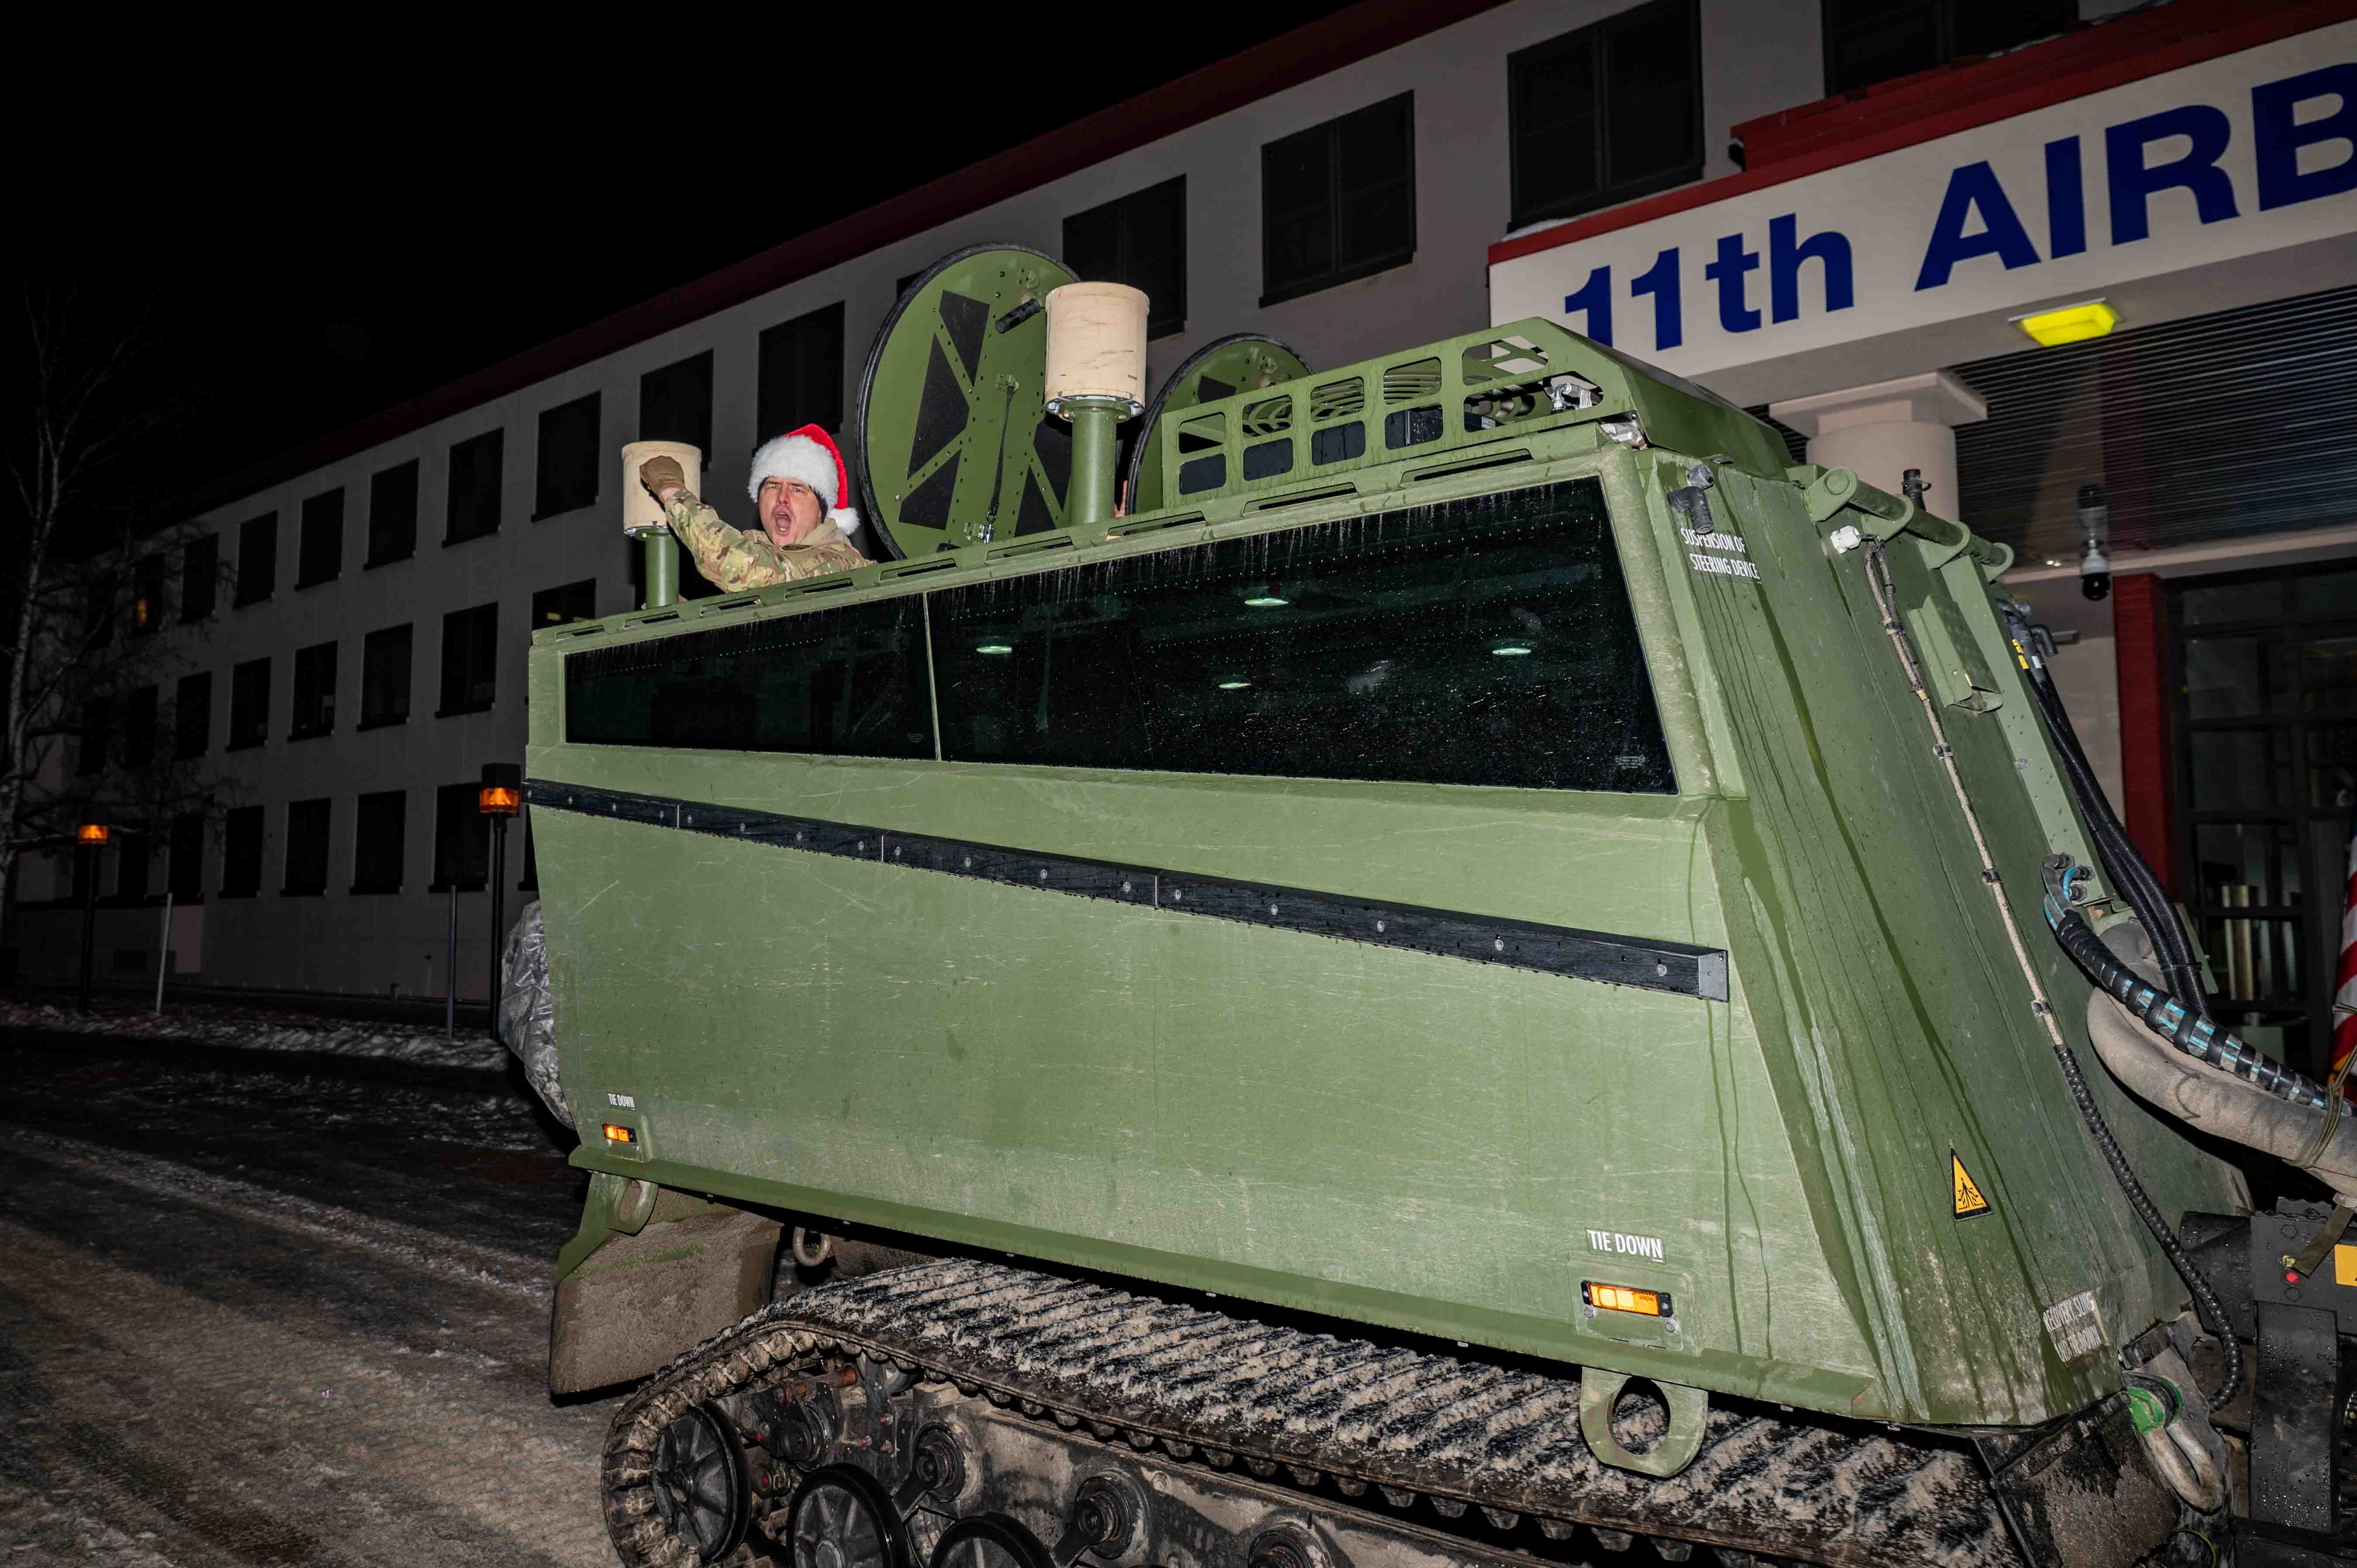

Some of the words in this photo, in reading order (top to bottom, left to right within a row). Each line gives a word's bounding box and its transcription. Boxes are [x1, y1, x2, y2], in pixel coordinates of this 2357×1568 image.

[1565, 213, 1854, 351] 11th
[1914, 63, 2357, 292] AIRB
[1681, 528, 1735, 551] SUSPENSION
[1734, 536, 1745, 553] OF
[1690, 553, 1731, 574] STEERING
[1731, 559, 1760, 580] DEVICE
[608, 1093, 618, 1105] TIE
[617, 1095, 635, 1108] DOWN
[1588, 1229, 1612, 1252] TIE
[1615, 1233, 1663, 1259] DOWN
[2043, 1299, 2079, 1334] RECOVERY
[2073, 1292, 2095, 1317] SLING
